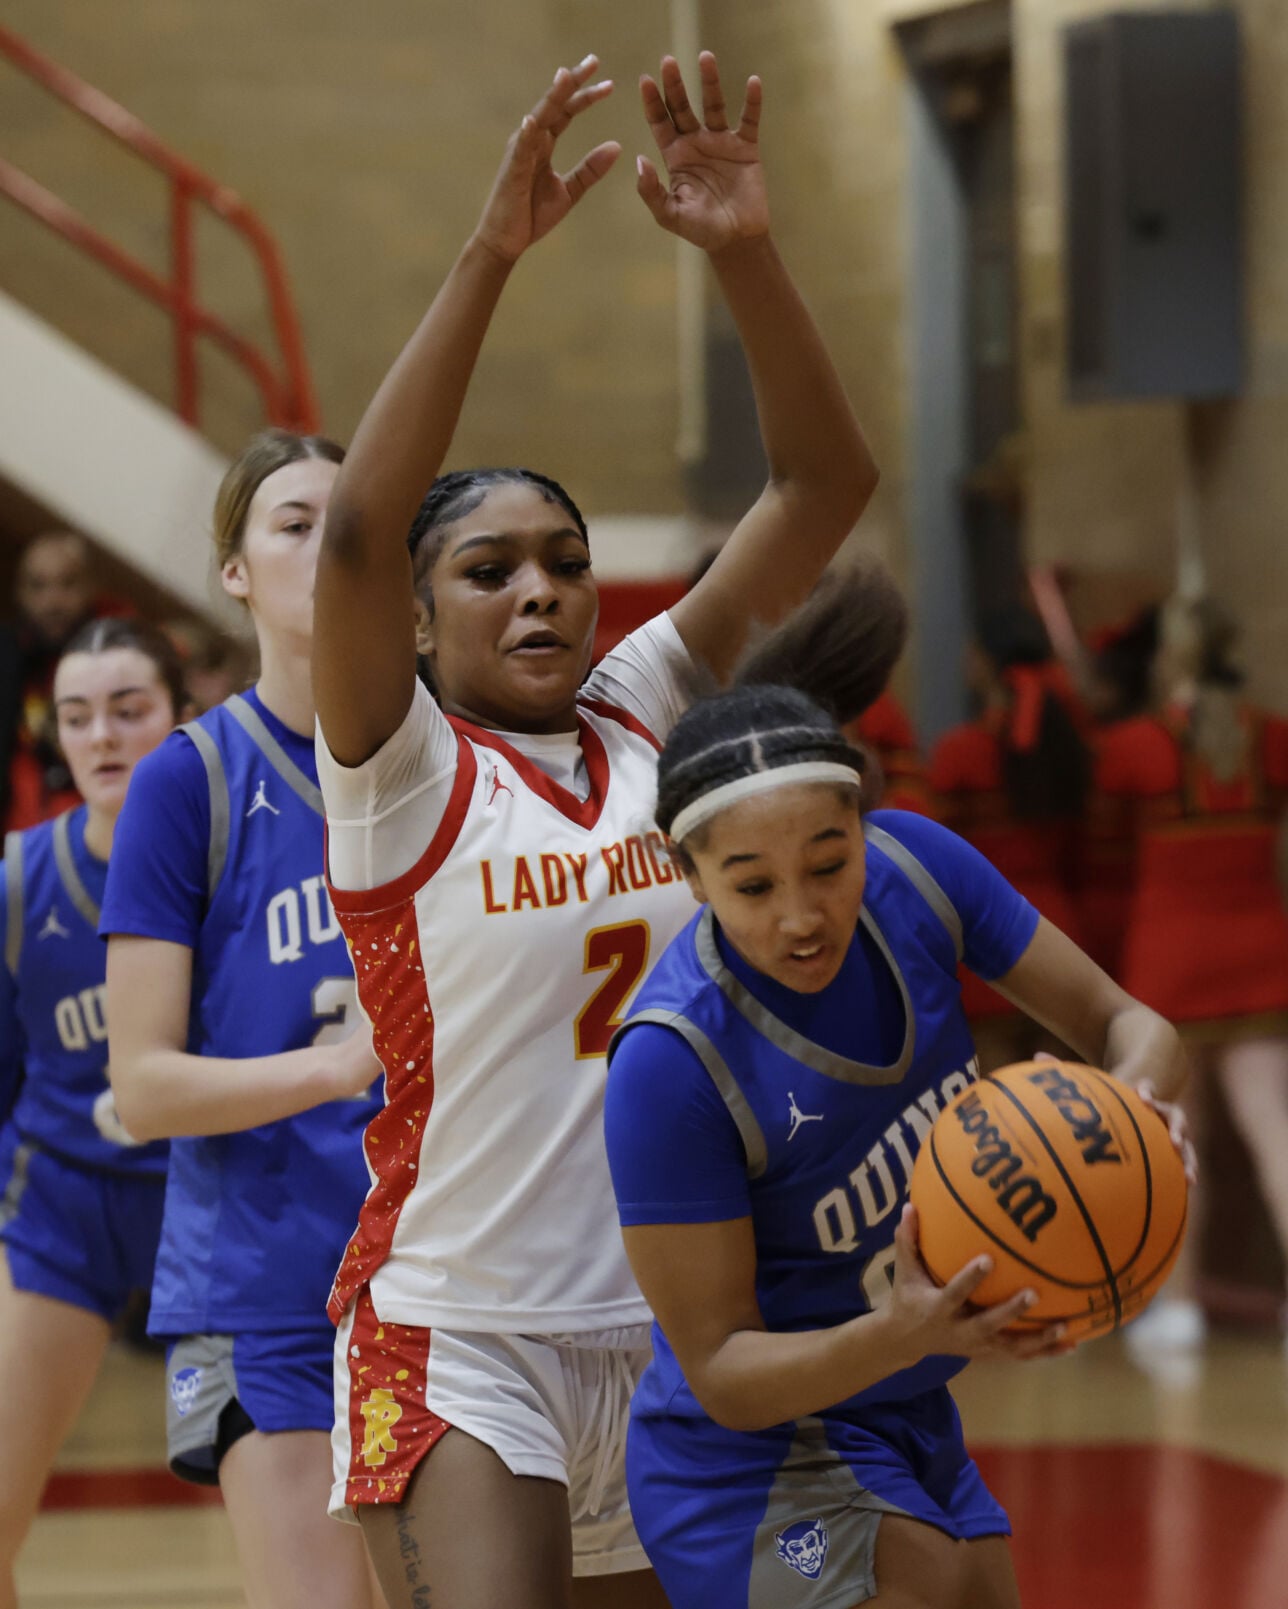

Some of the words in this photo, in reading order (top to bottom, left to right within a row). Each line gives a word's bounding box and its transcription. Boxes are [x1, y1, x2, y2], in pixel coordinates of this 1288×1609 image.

[480, 851, 590, 915] LADY
[572, 918, 651, 1061] 2
[953, 1090, 1058, 1243] Wilson
